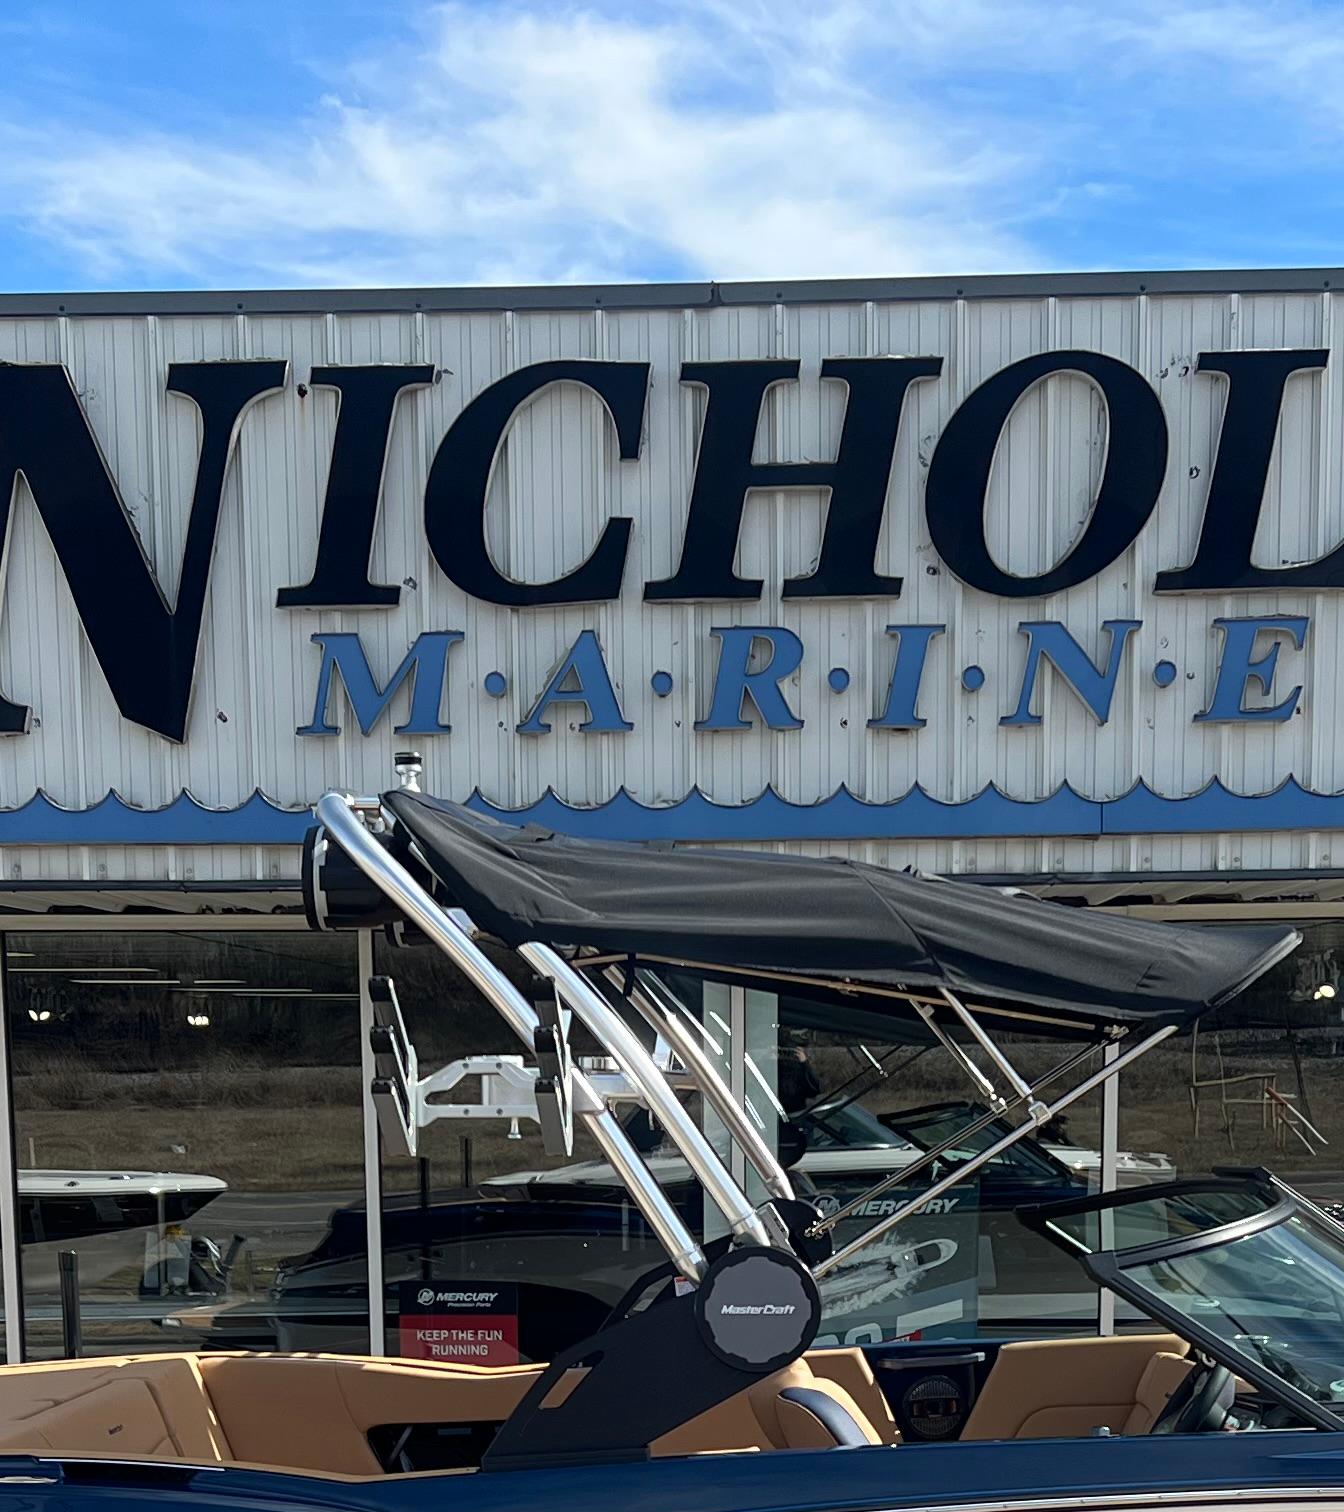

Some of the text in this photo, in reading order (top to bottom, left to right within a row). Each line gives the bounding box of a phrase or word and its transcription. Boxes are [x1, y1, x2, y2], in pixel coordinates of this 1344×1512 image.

[436, 1292, 499, 1302] MERCURY
[720, 1303, 796, 1316] MasterCraft
[417, 1329, 503, 1341] KEEP THE FUN
[432, 1344, 489, 1356] RUNNING
